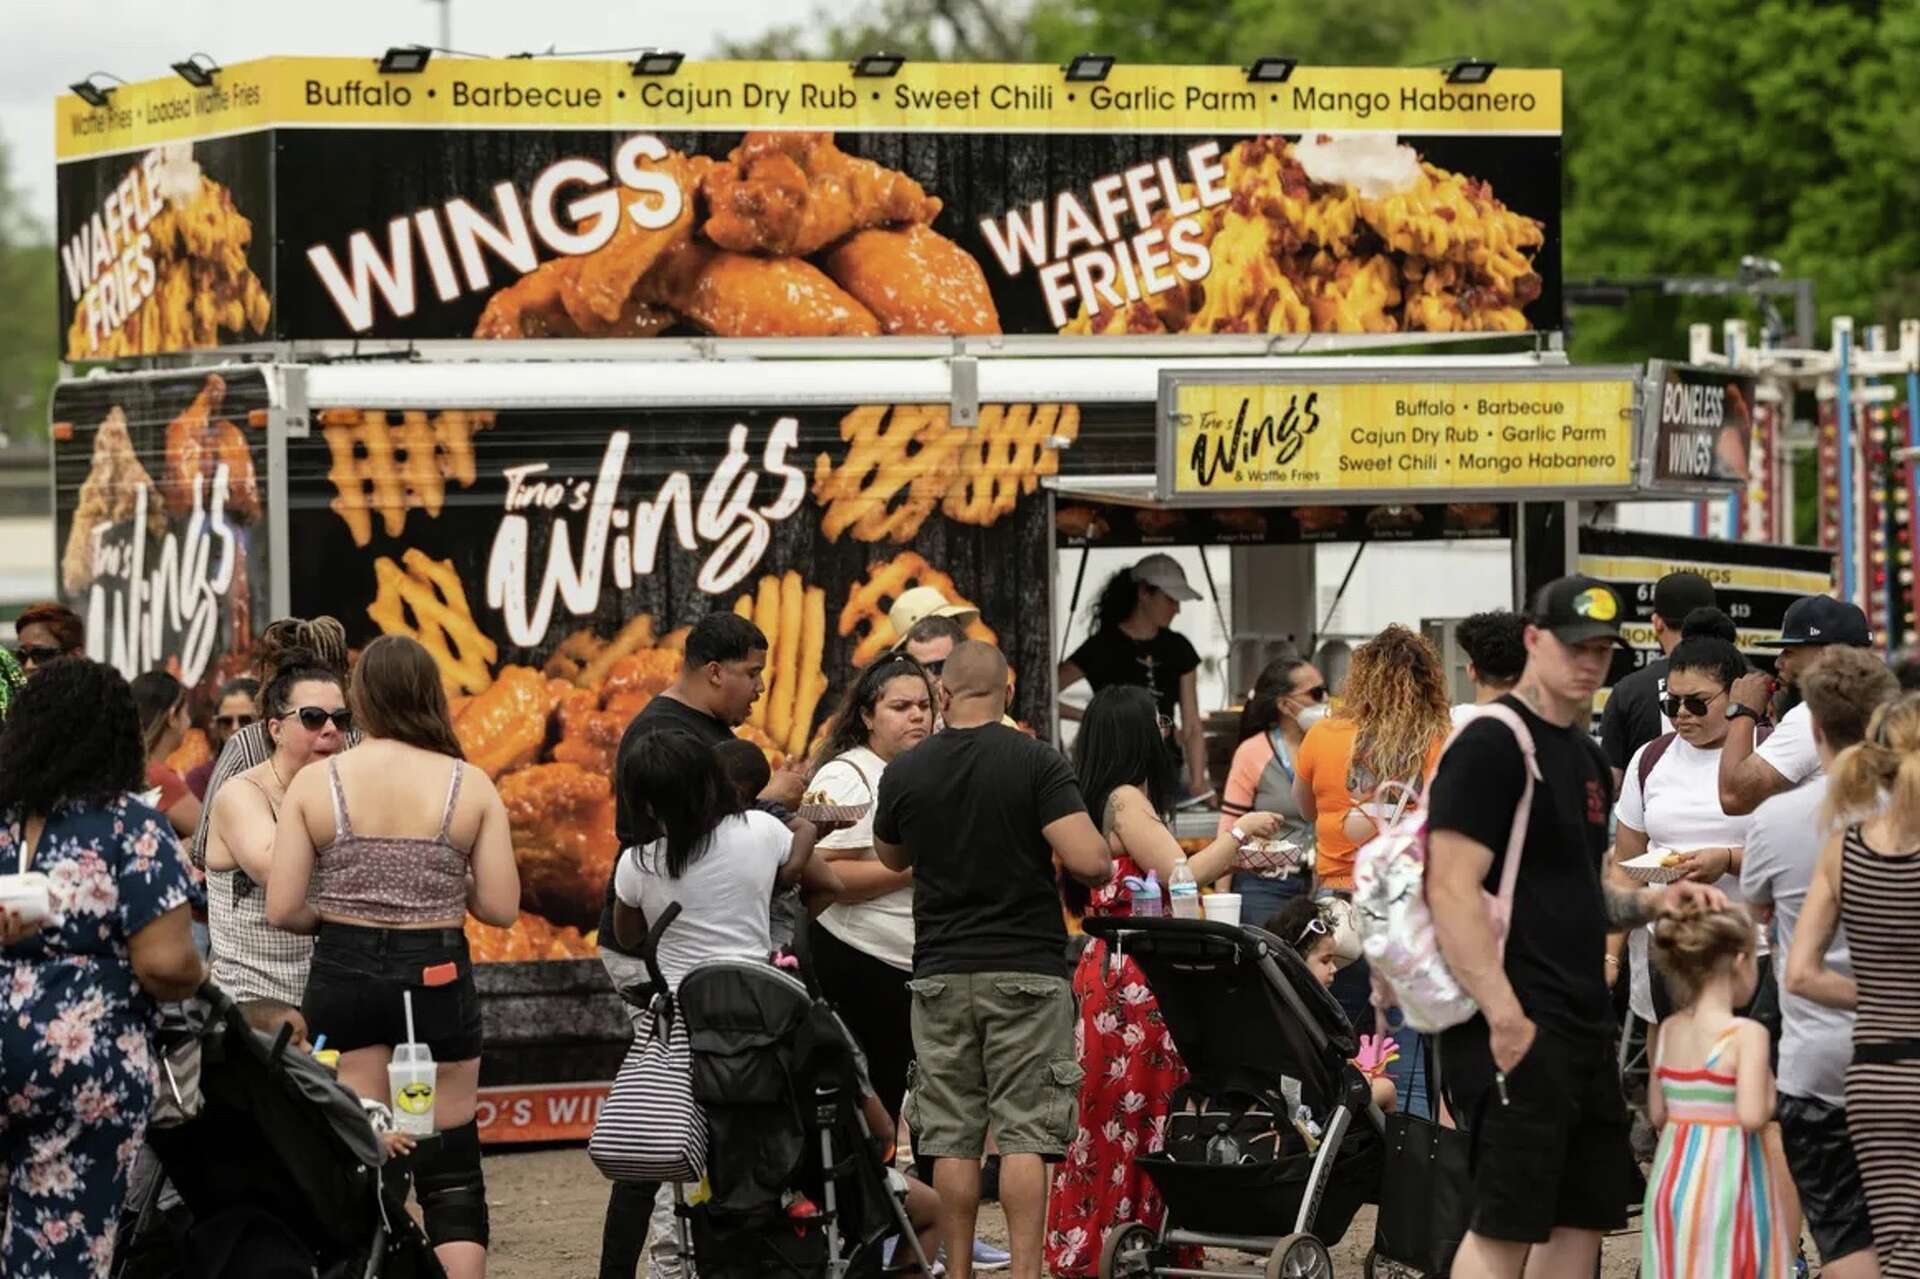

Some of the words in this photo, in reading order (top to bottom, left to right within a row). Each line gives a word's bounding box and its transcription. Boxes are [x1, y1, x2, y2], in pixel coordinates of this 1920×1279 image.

[146, 97, 191, 124] Loaded
[233, 82, 260, 107] Fries
[305, 80, 411, 107] Buffalo
[453, 81, 601, 108] Barbecue
[641, 82, 731, 113] Cajun
[744, 83, 790, 113] Dry
[801, 83, 857, 109] Rub
[895, 84, 979, 110] Sweet
[990, 84, 1053, 110] Chili
[1090, 85, 1175, 111] Garlic
[1186, 86, 1256, 111] Parm
[1293, 86, 1390, 118] Mango
[1400, 87, 1536, 112] Habanero
[61, 147, 164, 302] WAFFLE
[306, 134, 685, 332] WINGS
[980, 141, 1232, 276] WAFFLE
[84, 233, 156, 351] FRIES
[1039, 219, 1212, 328] FRIES
[1396, 400, 1455, 416] Buffalo
[1477, 399, 1564, 415] Barbecue
[1663, 383, 1724, 427] BONELESS
[1191, 392, 1320, 486] Wings
[1350, 427, 1406, 448] Cajun
[1412, 427, 1440, 446] Dry
[1445, 426, 1478, 442] Rub
[1502, 426, 1556, 442] Garlic
[1562, 426, 1606, 441] Parm
[1669, 433, 1712, 475] WINGS
[503, 462, 591, 511] Tino's
[1234, 471, 1243, 482] &
[1249, 469, 1286, 482] Waffle
[1291, 469, 1320, 481] Fries
[1339, 455, 1392, 471] Sweet
[1398, 454, 1437, 470] Chili
[1459, 454, 1522, 473] Mango
[1529, 453, 1616, 469] Habanero
[487, 417, 806, 648] Wings
[86, 464, 235, 689] Wings
